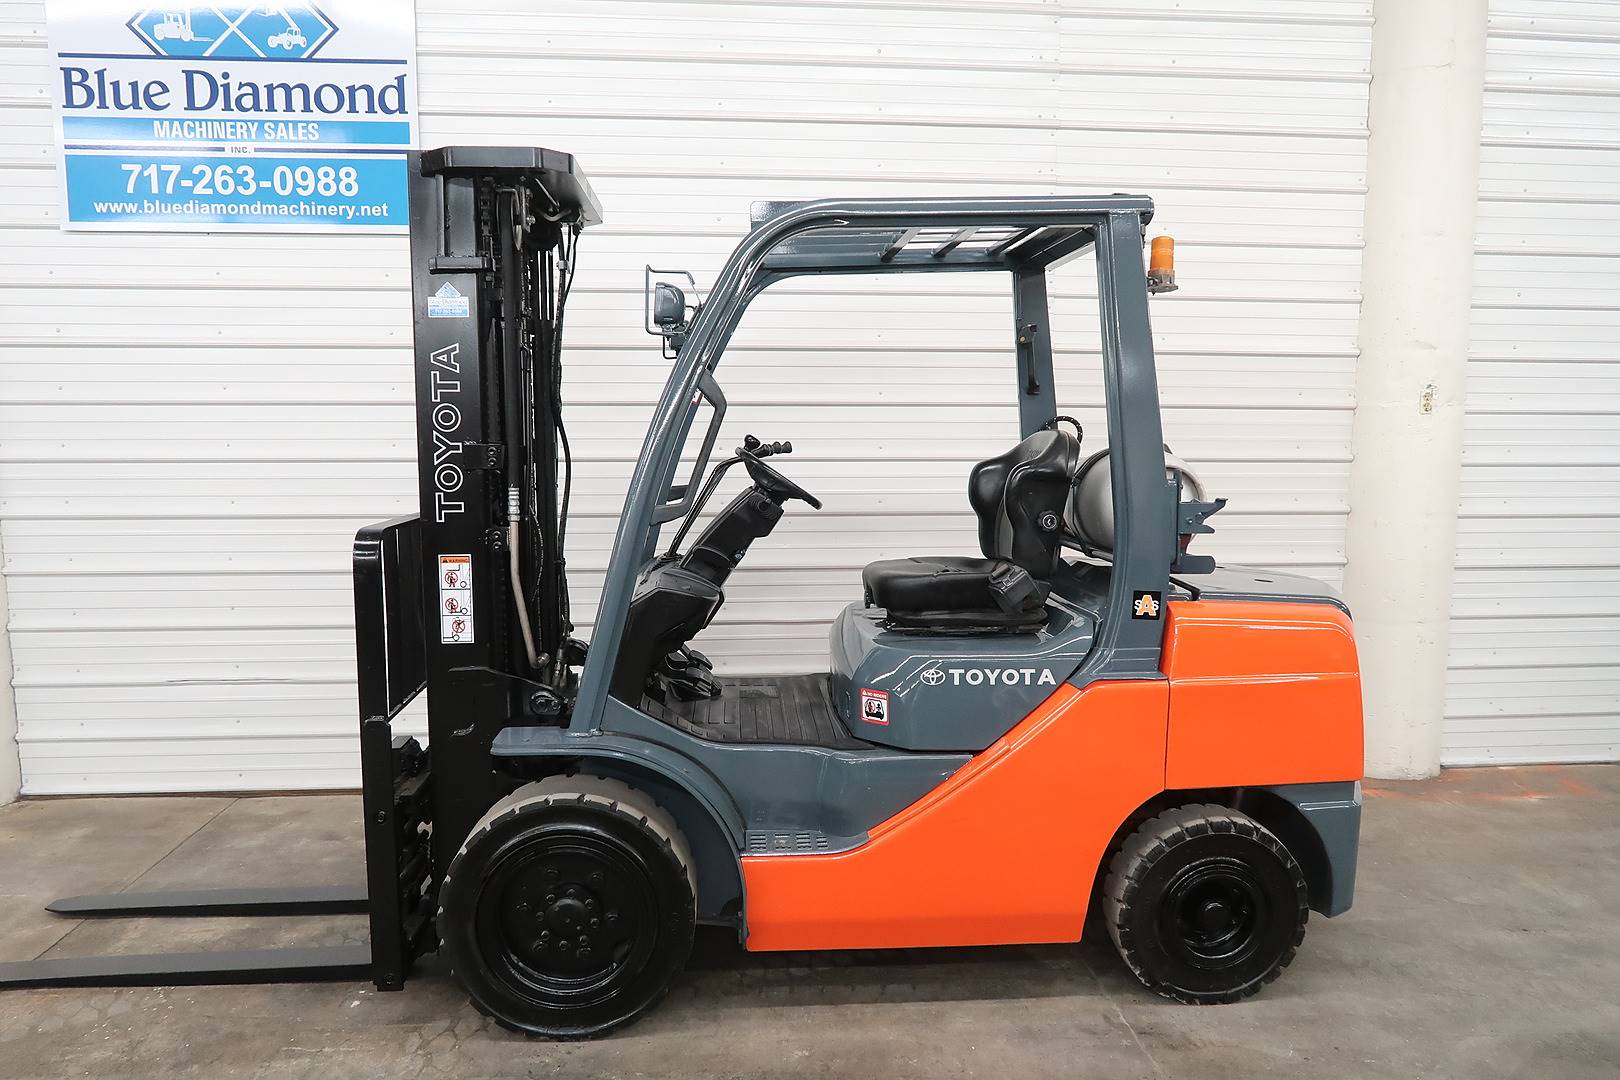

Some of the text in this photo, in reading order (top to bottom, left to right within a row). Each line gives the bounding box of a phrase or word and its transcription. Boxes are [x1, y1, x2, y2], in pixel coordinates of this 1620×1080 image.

[60, 66, 409, 115] Blue Diamond
[153, 121, 320, 141] MACHINERY SALES
[230, 146, 251, 154] INC.
[120, 163, 359, 197] 717-263-0988
[93, 200, 389, 219] www.bluediamondmachinery.net
[430, 342, 465, 523] TOYOTA
[948, 668, 1057, 686] TOYOTA
